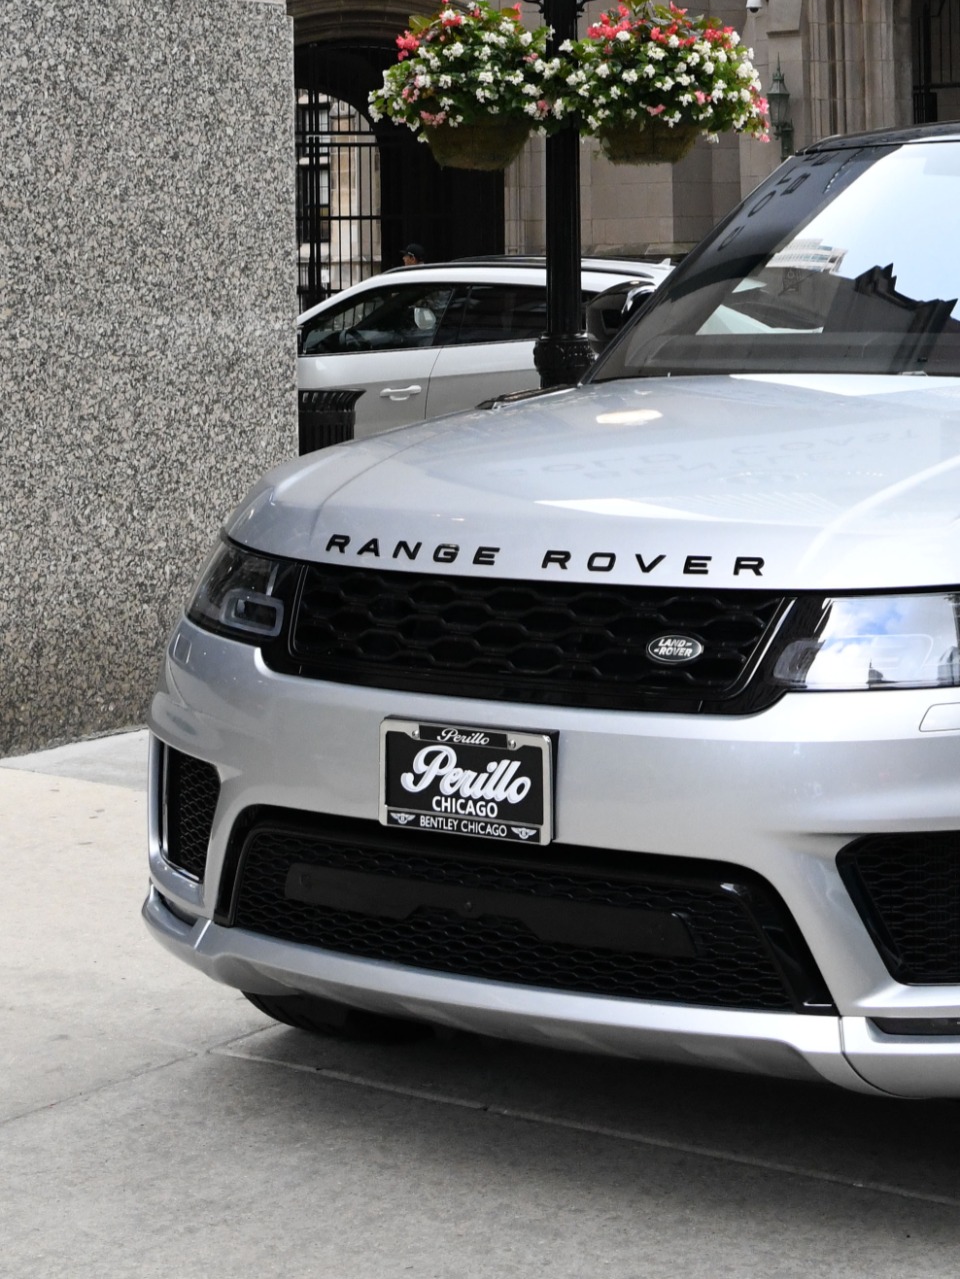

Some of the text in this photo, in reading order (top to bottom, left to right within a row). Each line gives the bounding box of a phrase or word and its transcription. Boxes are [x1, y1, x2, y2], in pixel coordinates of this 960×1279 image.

[325, 533, 765, 576] RANGE ROVER
[436, 727, 490, 746] Perillo
[400, 745, 531, 804] Perillo
[432, 796, 498, 818] CHICAGO
[419, 815, 508, 837] BENTLEY CHICAGO
